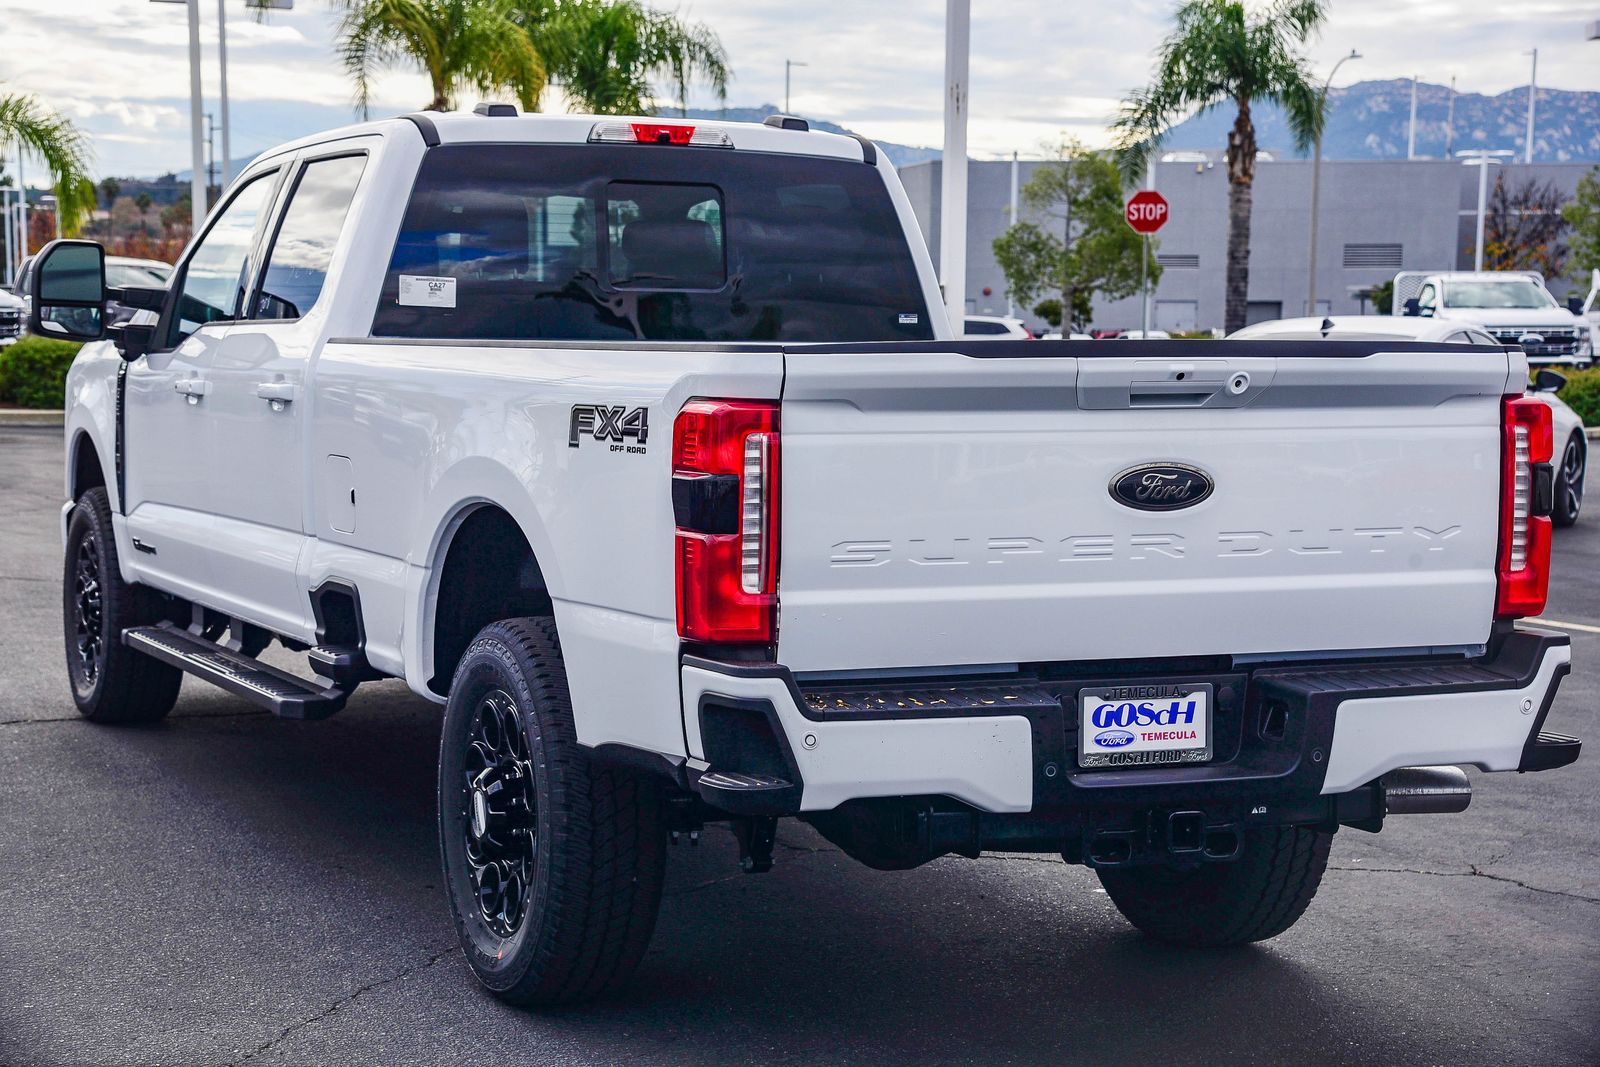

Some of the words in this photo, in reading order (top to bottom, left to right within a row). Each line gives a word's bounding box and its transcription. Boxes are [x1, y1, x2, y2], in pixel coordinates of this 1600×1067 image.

[1129, 203, 1166, 220] STOP
[428, 281, 446, 289] CA27
[568, 403, 649, 448] FX4
[626, 446, 647, 454] ROAD
[1136, 473, 1192, 500] Ford
[830, 533, 1185, 568] SUPER
[1217, 525, 1462, 558] DUTY
[1111, 686, 1180, 699] TEMECULA
[1100, 733, 1129, 746] Ford
[1141, 730, 1197, 742] TEMECULA
